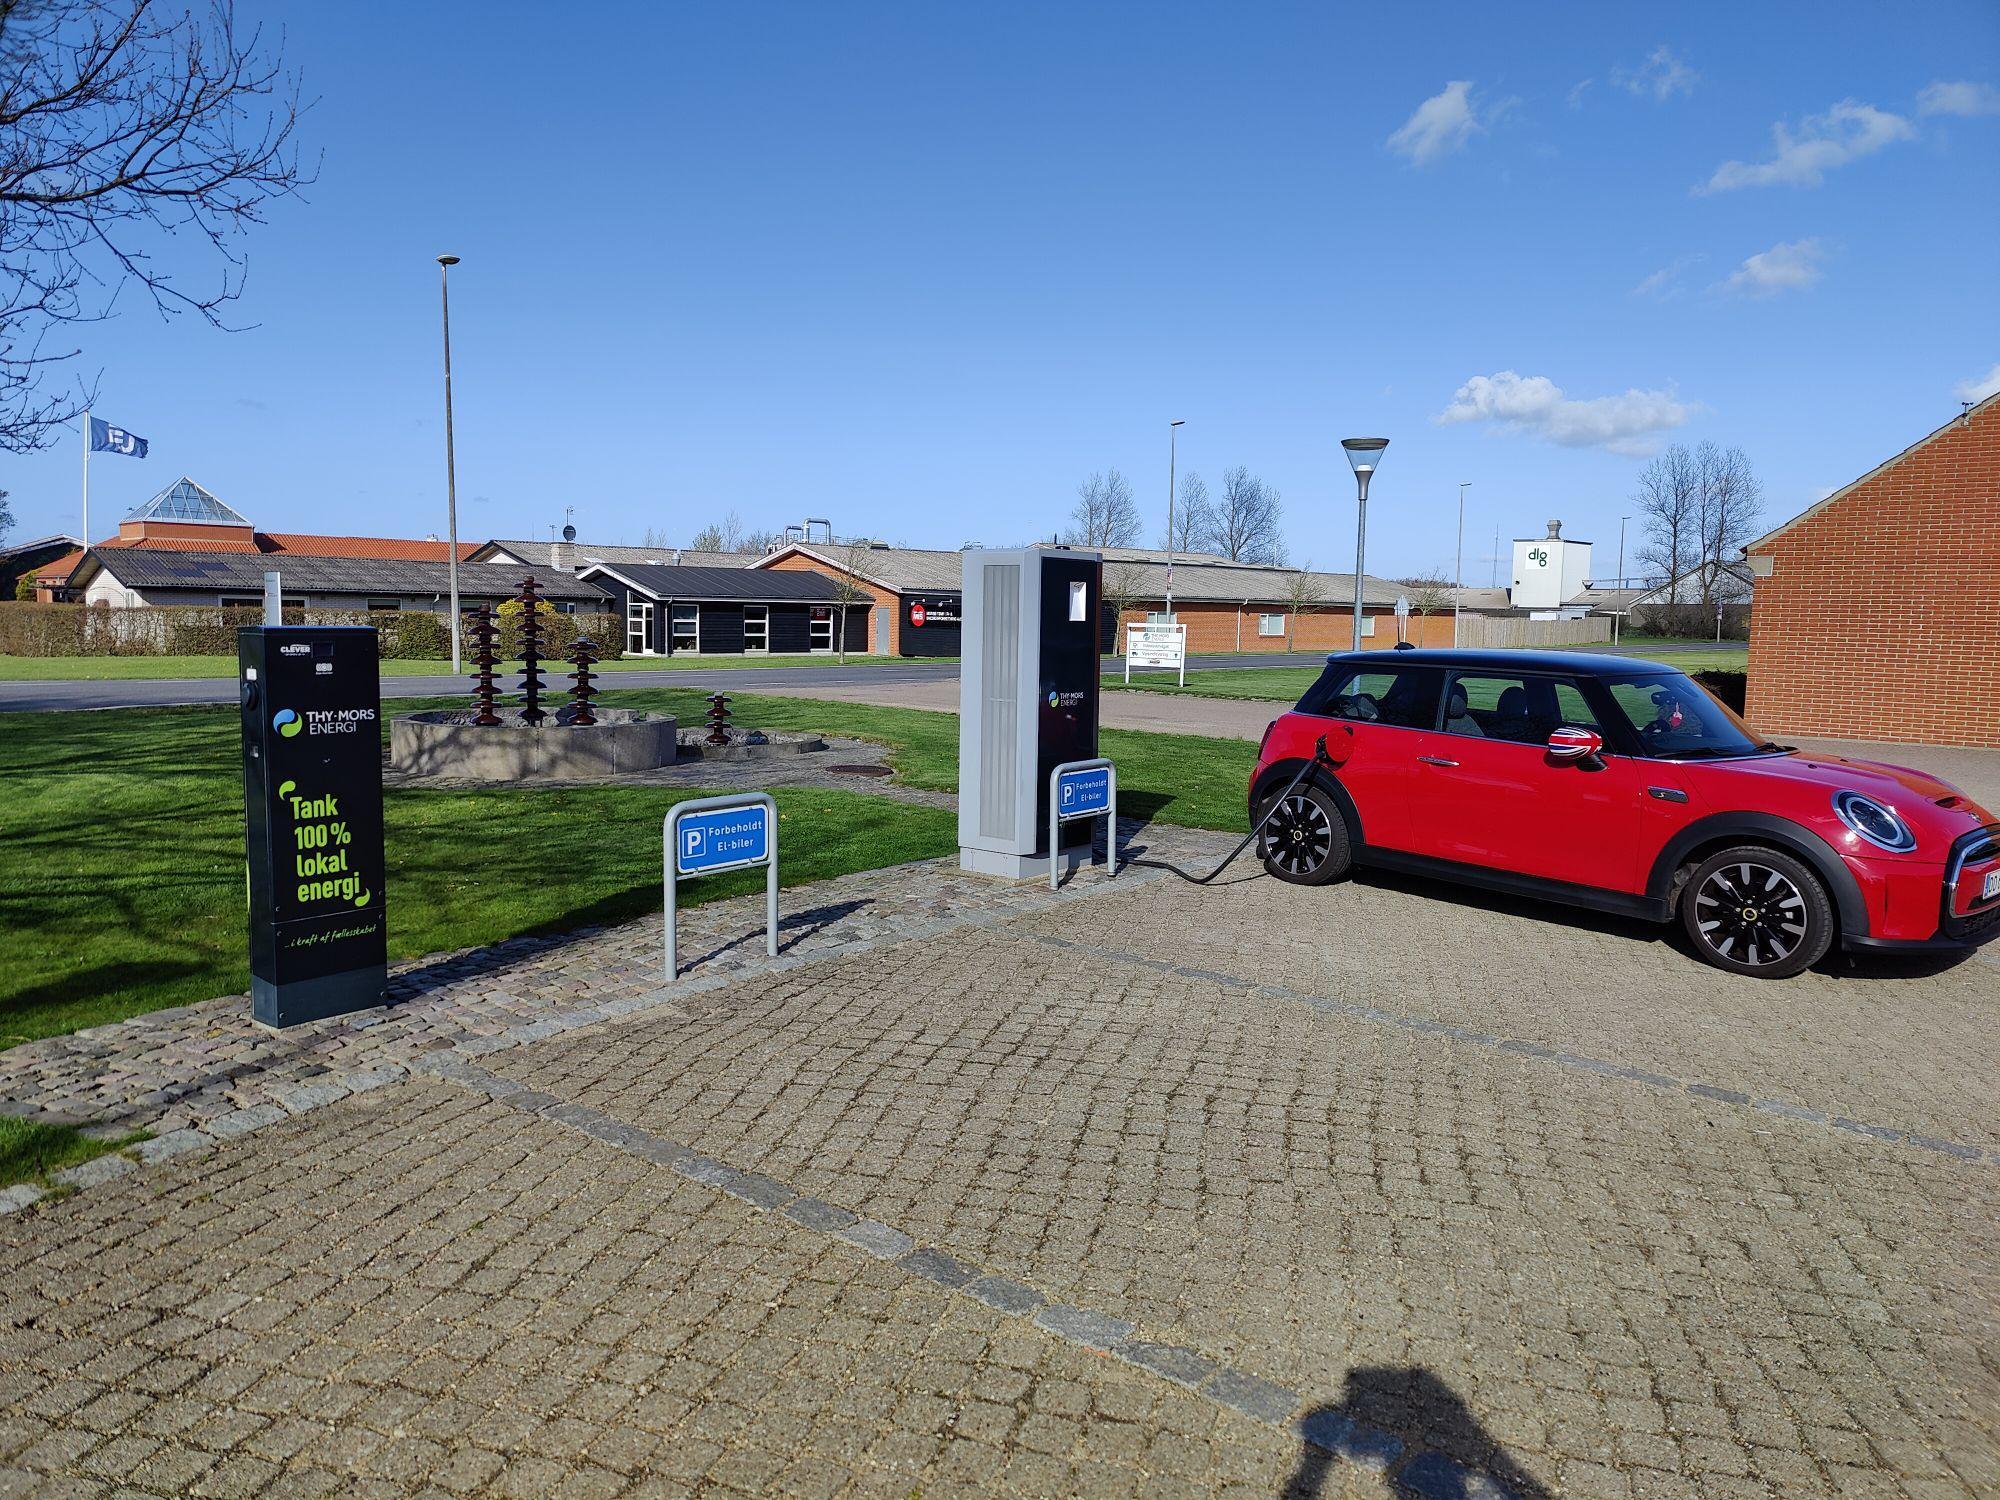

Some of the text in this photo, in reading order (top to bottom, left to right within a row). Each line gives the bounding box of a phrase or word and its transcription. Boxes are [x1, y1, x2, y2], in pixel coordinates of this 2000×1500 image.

[1528, 547, 1548, 567] dlg
[279, 644, 311, 653] CLEVER
[309, 721, 357, 735] ENERGI
[1076, 779, 1107, 791] Forbeholdt
[1081, 792, 1103, 802] El-biler
[290, 794, 339, 820] Tank
[687, 820, 762, 855] P Forbeholdt
[717, 838, 754, 852] El-biler
[296, 849, 349, 878] lokal
[297, 871, 360, 903] energi
[296, 933, 319, 947] kraft
[320, 931, 331, 944] af
